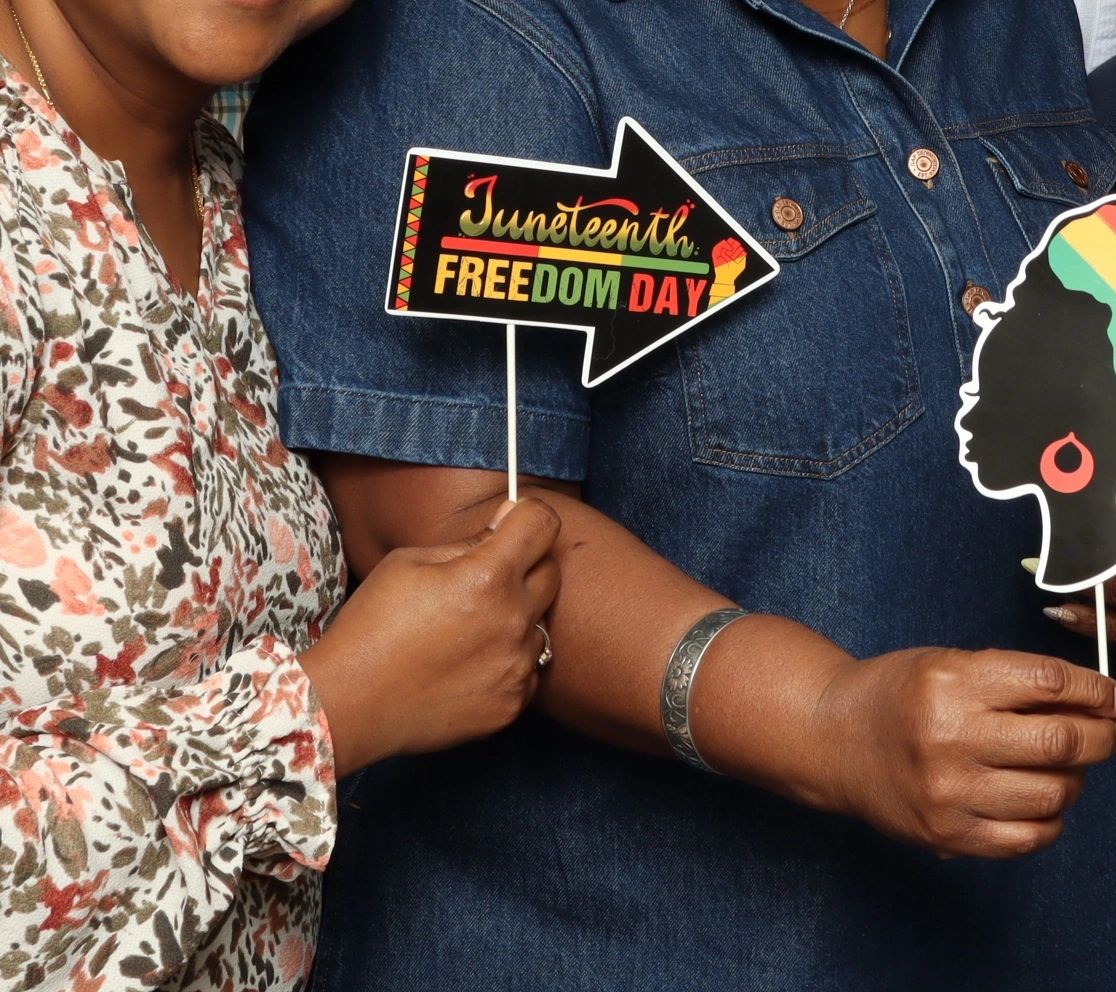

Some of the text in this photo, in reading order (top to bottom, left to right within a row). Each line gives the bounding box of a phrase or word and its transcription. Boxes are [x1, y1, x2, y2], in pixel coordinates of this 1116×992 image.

[459, 174, 696, 259] Juneteenth
[434, 253, 708, 317] FREEDOM DAY
